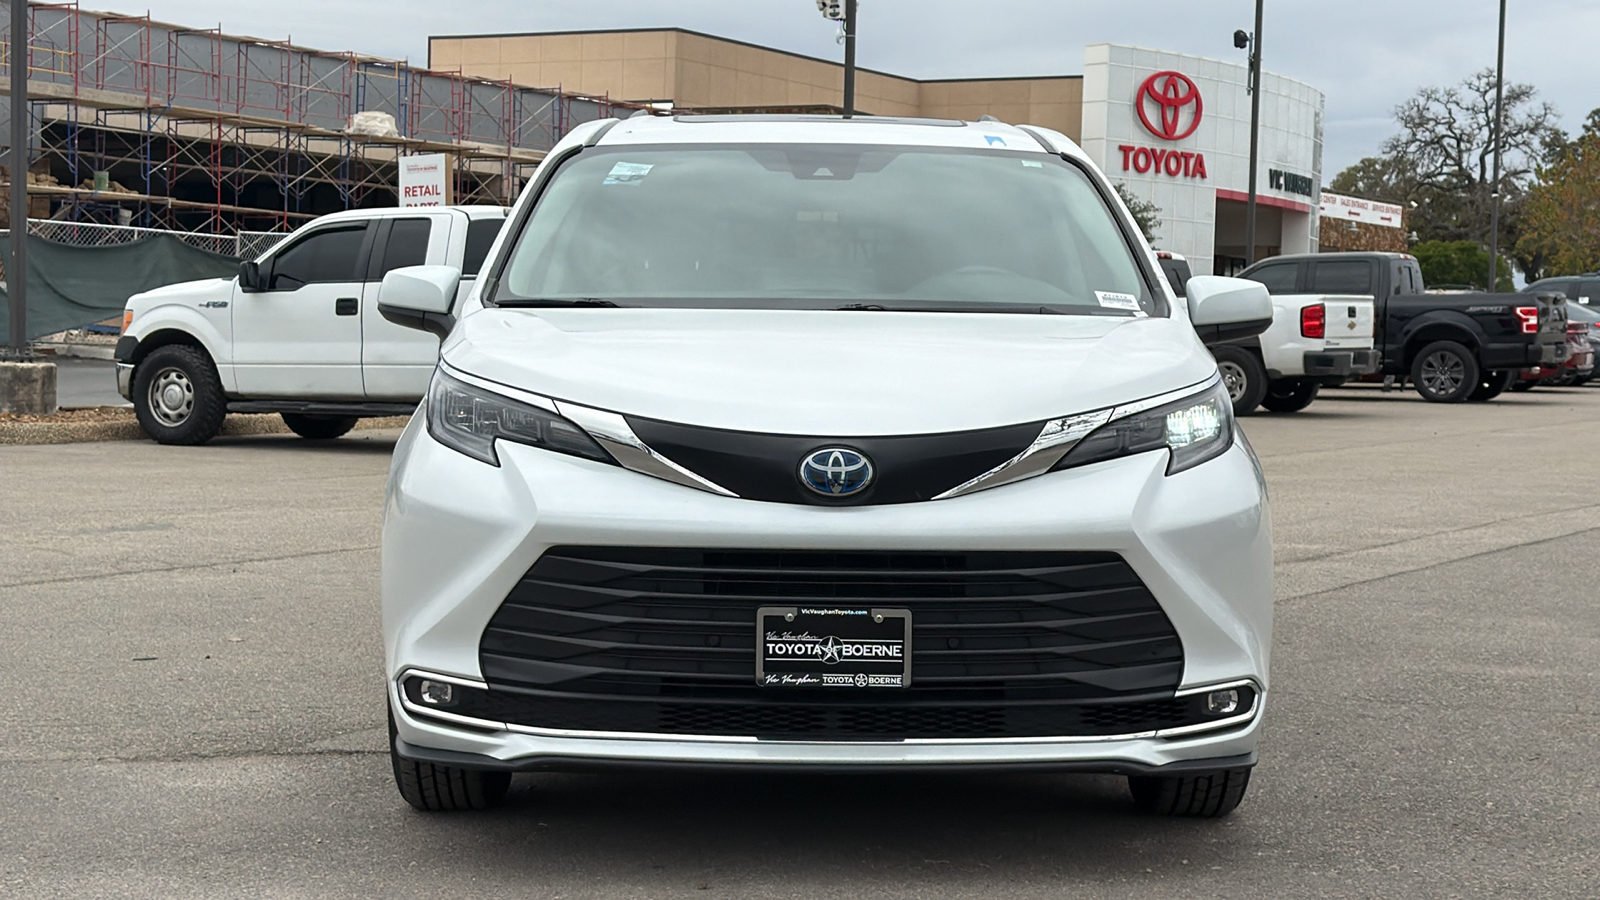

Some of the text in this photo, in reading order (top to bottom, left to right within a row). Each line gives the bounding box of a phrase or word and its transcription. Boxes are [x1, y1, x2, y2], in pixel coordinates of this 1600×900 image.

[1118, 145, 1207, 179] TOYOTA
[1269, 168, 1283, 191] VIC
[404, 184, 441, 198] RETAIL
[801, 608, 868, 616] VicVaughanToyota.com
[767, 643, 822, 655] TOYOTA
[842, 644, 903, 657] BOERNE
[823, 676, 854, 684] TOYOTA
